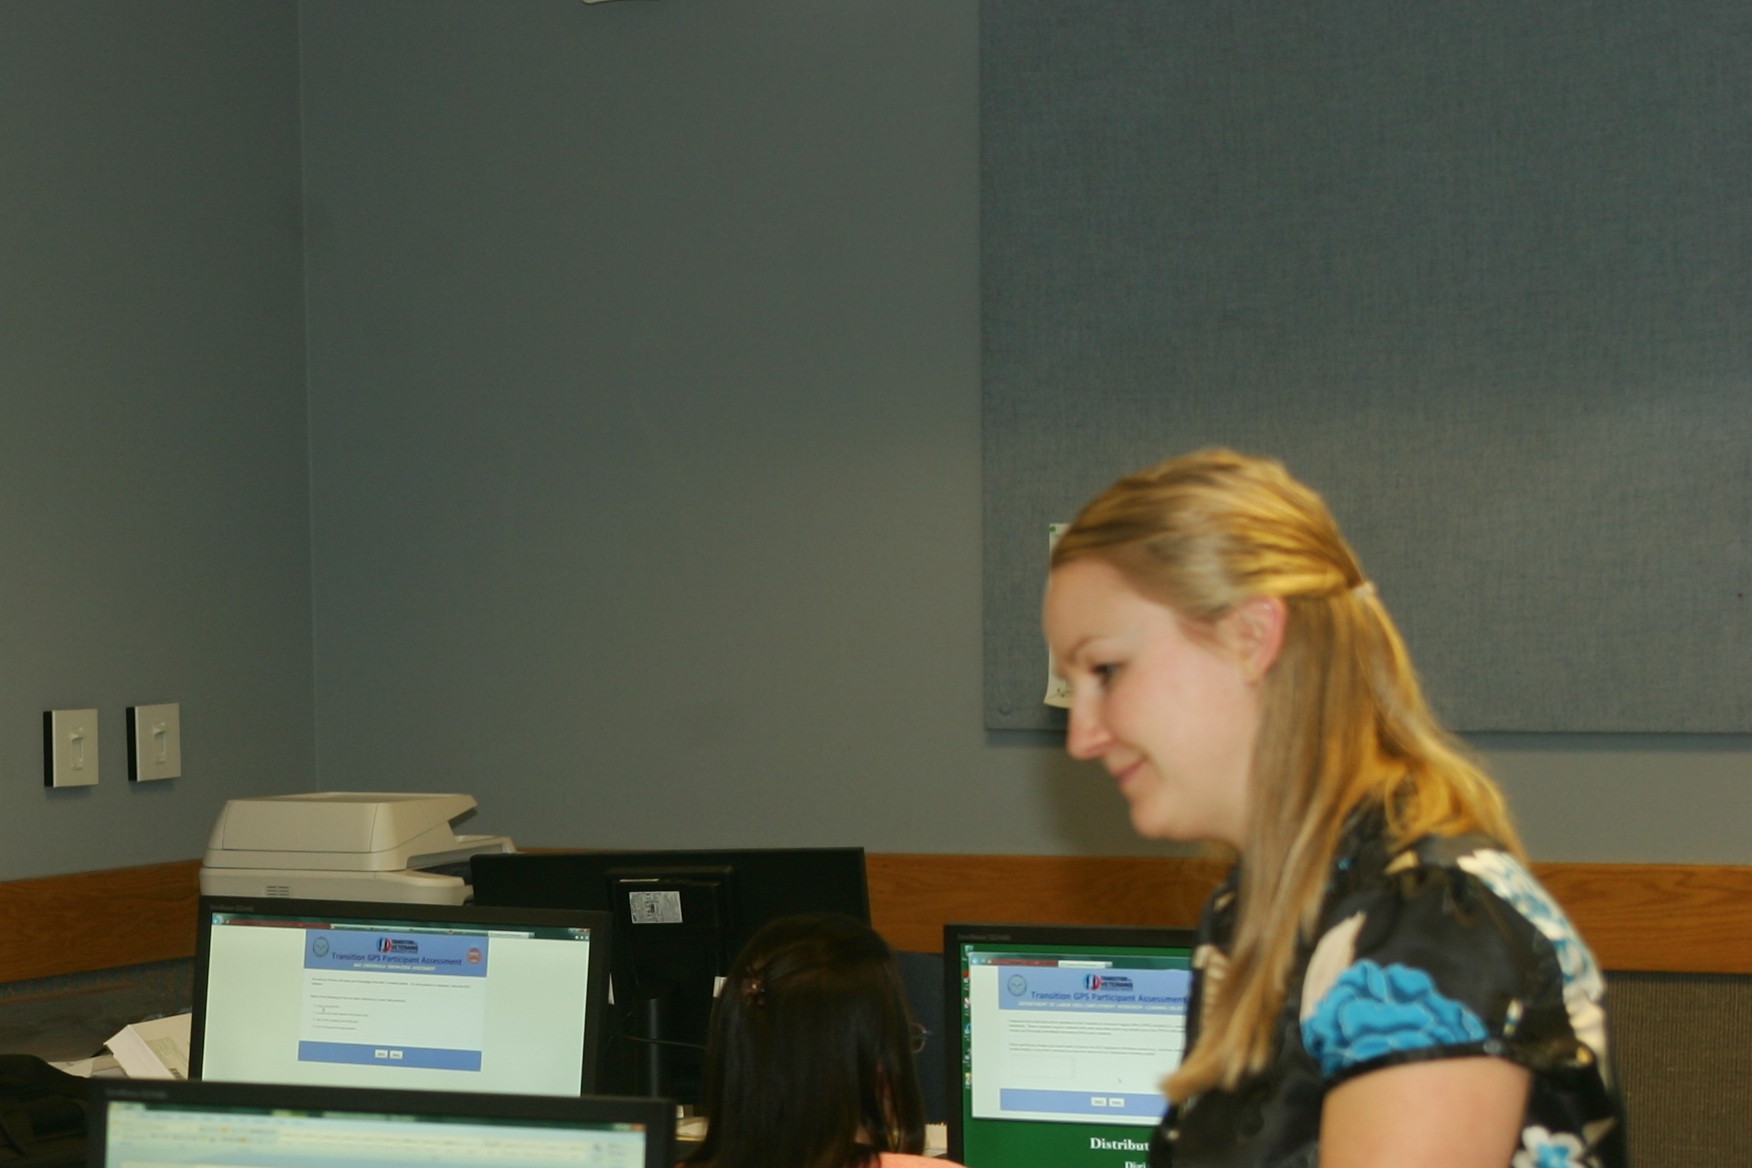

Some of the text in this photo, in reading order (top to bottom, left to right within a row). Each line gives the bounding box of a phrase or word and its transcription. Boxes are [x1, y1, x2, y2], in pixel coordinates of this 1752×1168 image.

[1031, 991, 1071, 1001] Transition
[1073, 992, 1090, 1002] GPS
[1091, 993, 1136, 1003] Participant
